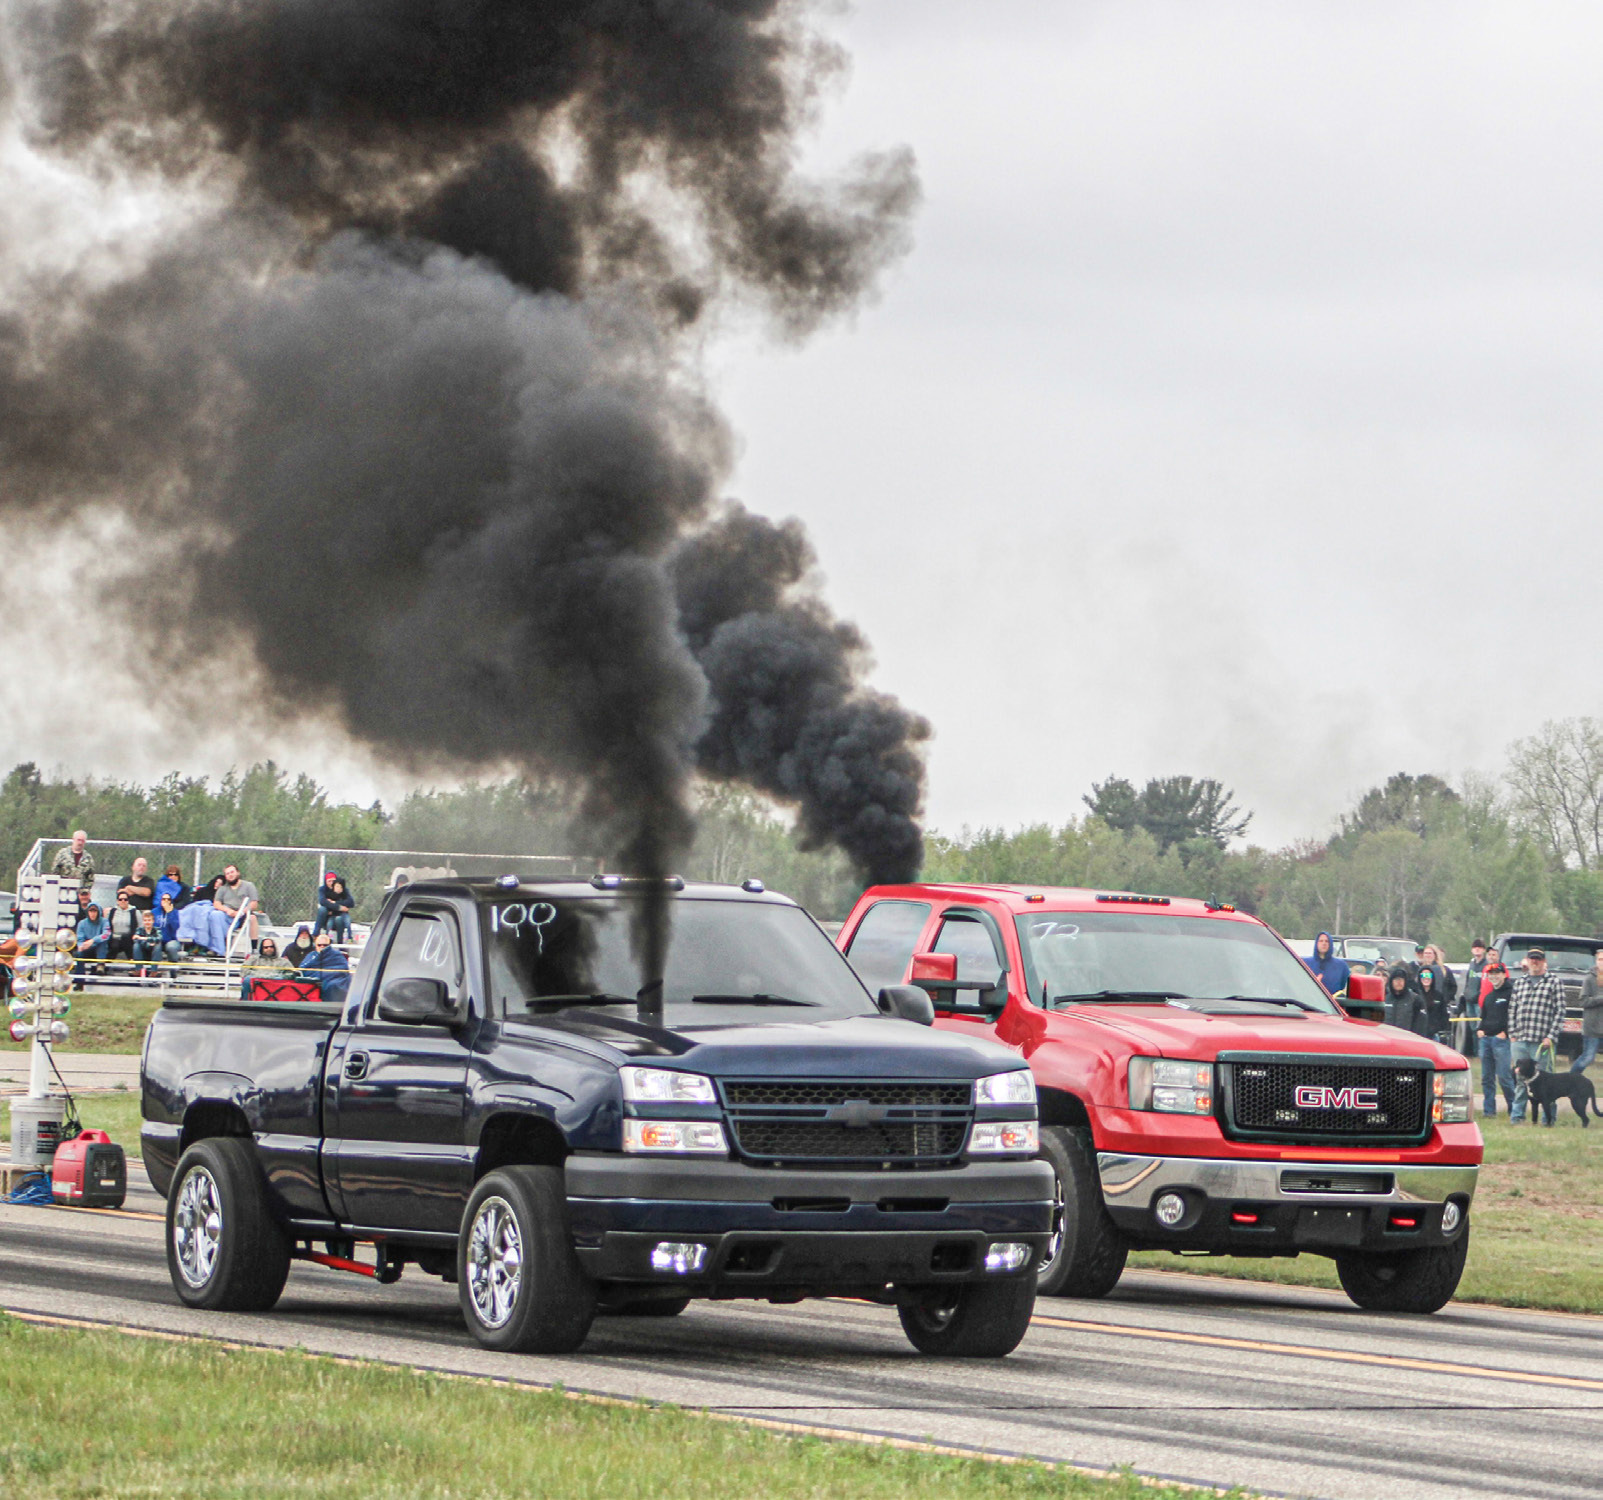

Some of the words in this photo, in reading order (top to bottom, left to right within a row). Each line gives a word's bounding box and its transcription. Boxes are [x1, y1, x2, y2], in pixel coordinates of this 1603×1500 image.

[491, 903, 557, 937] 100
[1031, 921, 1080, 940] 72
[419, 924, 451, 967] 100
[1295, 1086, 1378, 1109] GMC
